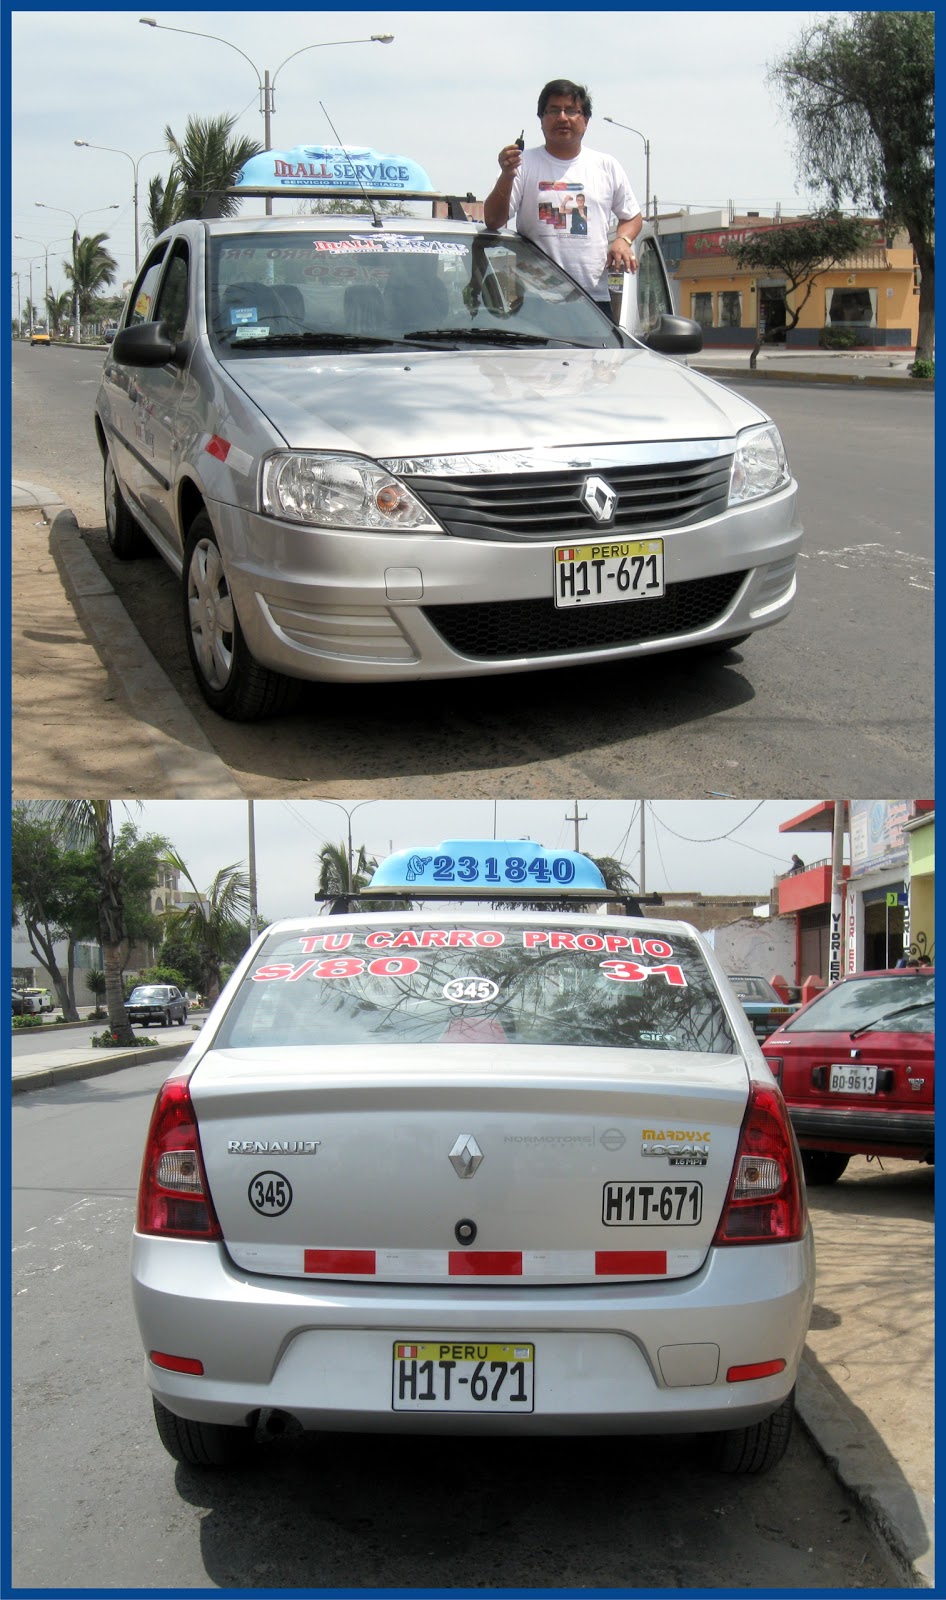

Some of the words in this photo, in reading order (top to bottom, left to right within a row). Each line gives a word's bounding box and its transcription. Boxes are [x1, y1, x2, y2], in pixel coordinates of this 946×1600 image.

[274, 160, 333, 179] MALL
[333, 162, 410, 181] SERVICE
[592, 545, 629, 559] PERU
[560, 555, 660, 597] H1T-671
[433, 856, 575, 884] 231840
[301, 933, 353, 953] TU
[366, 930, 505, 949] CARRO
[523, 931, 673, 958] PROPIO
[830, 913, 841, 984] VIDRIER
[252, 957, 420, 982] S/80
[600, 960, 688, 986] 31
[451, 982, 490, 998] 345
[227, 1140, 321, 1155] RENAULT
[641, 1143, 710, 1158] LOGAN
[255, 1180, 286, 1208] 345
[606, 1186, 699, 1221] H1T-671
[440, 1345, 488, 1359] PERU
[399, 1360, 527, 1402] H1T-671
